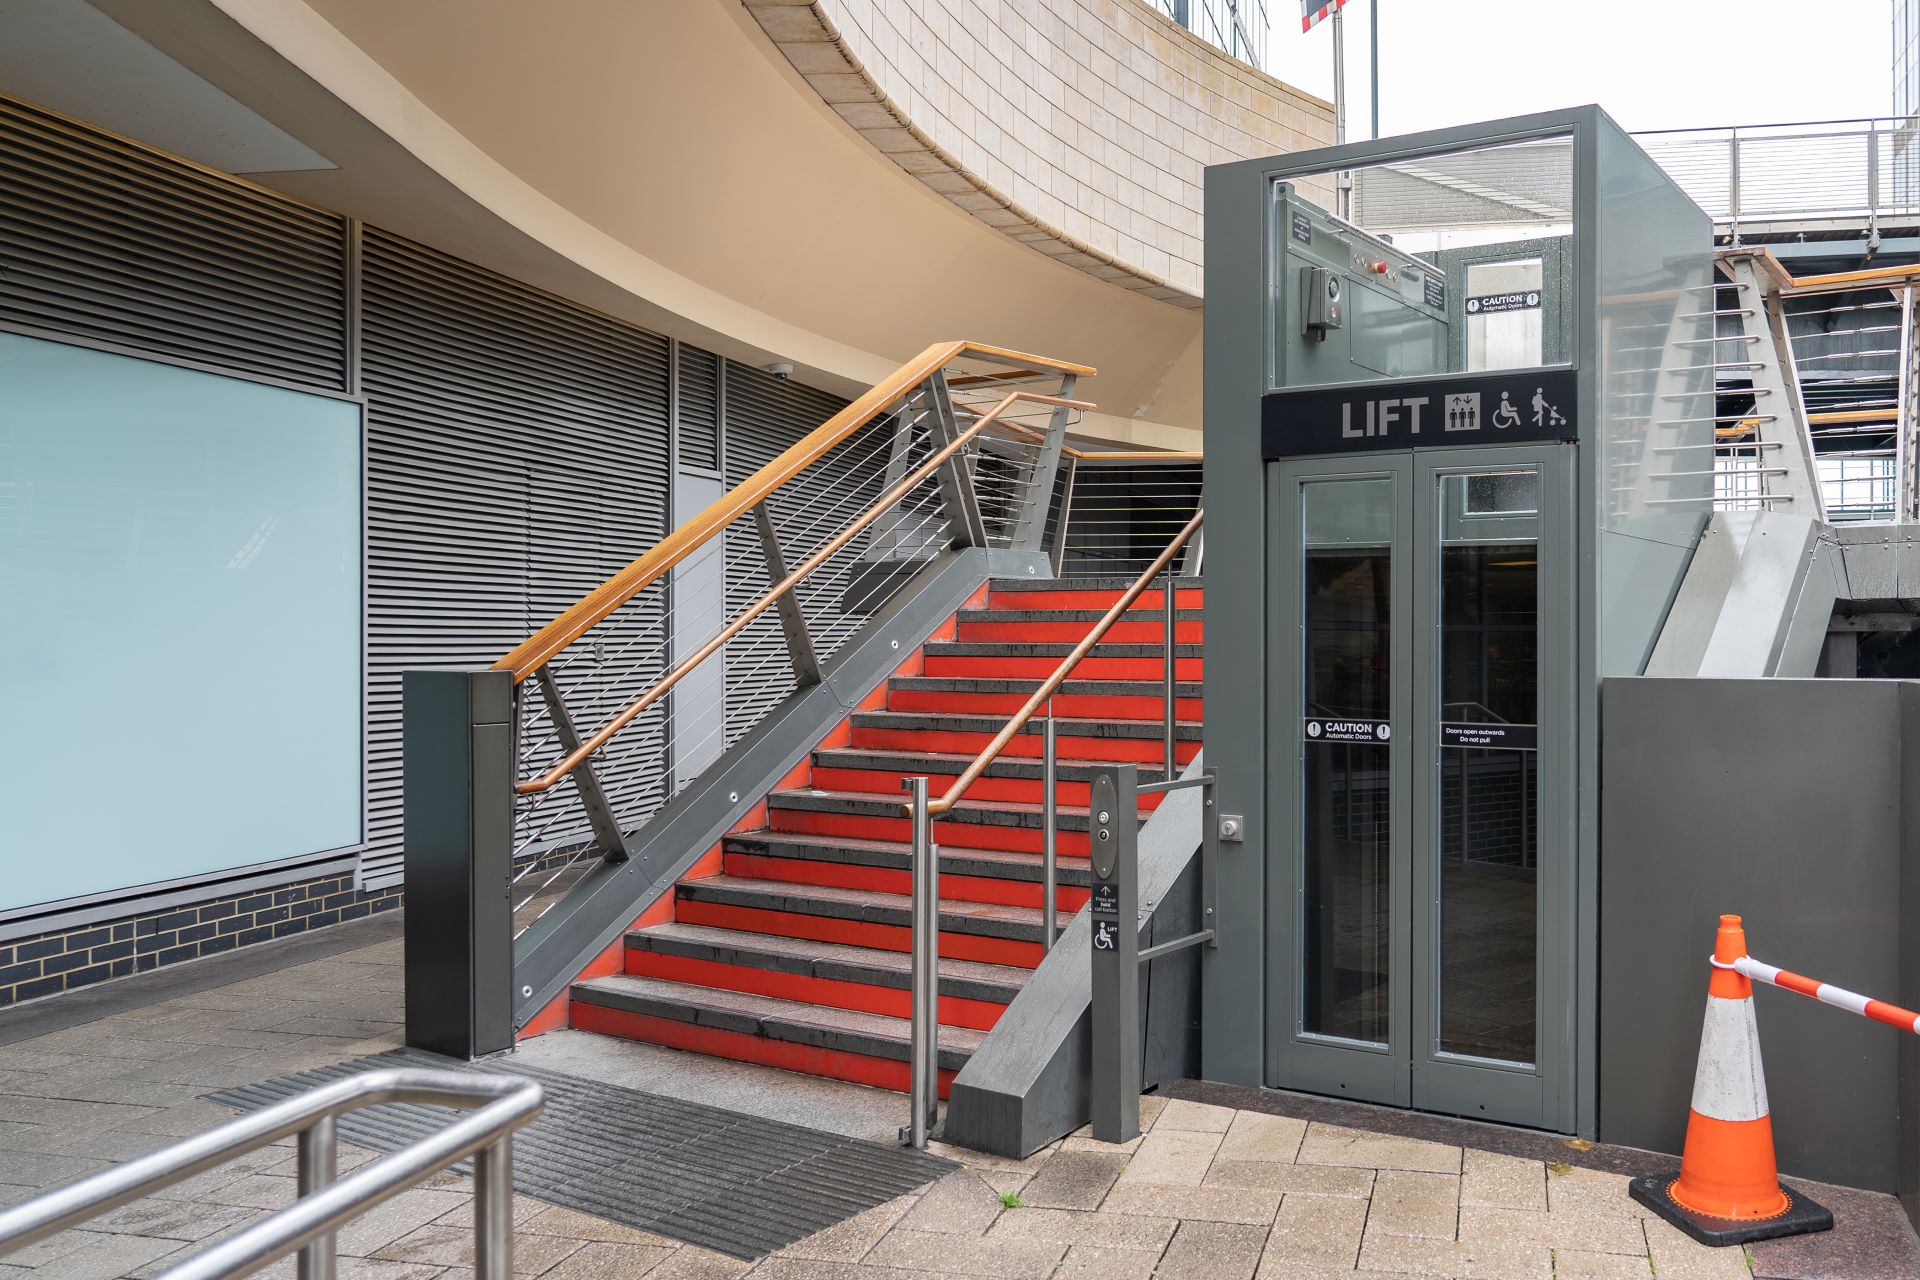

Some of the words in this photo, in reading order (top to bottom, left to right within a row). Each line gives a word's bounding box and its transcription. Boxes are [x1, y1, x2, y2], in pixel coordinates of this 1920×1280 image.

[1483, 295, 1523, 305] CAUTION
[1342, 397, 1429, 438] LIFT
[1326, 722, 1372, 733] CAUTION
